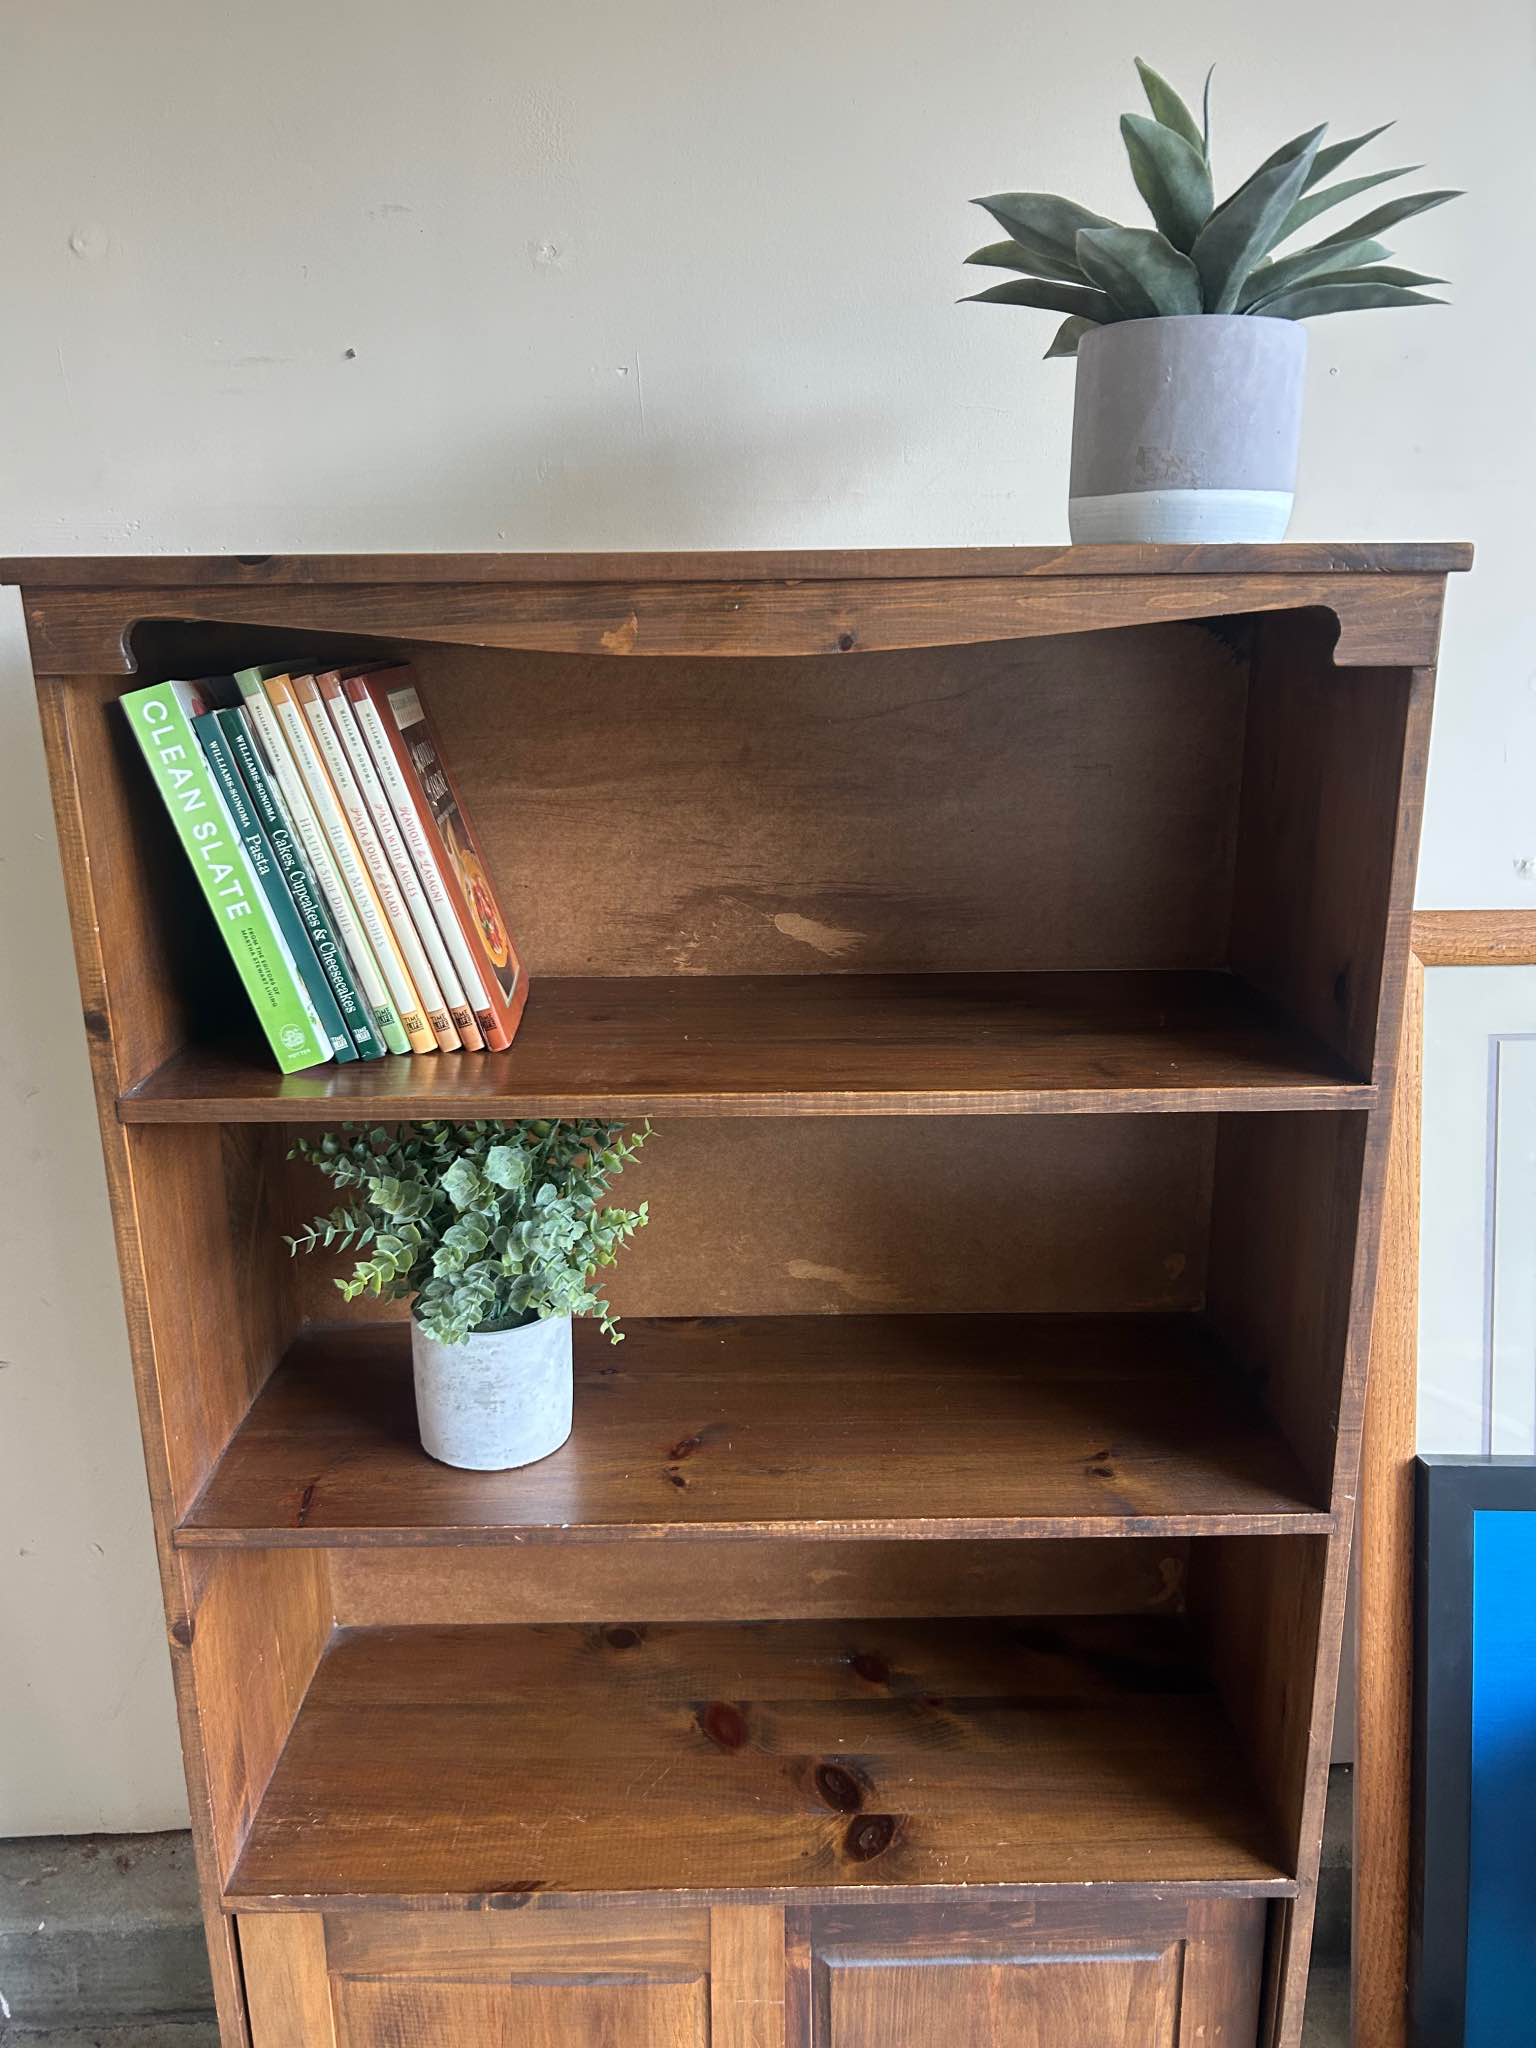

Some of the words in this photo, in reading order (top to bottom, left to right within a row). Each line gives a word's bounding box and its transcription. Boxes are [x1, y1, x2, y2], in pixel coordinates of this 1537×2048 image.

[143, 700, 207, 812] CLEAN
[192, 821, 252, 920] SLATE
[245, 833, 271, 876] Pasta
[272, 829, 295, 871] Cakes,
[299, 817, 326, 868] HEALTHY
[320, 868, 337, 894] SIDE
[331, 895, 352, 934] DISHES
[329, 824, 357, 876] HEALTHY
[350, 875, 370, 908] MAIN
[364, 908, 385, 947] DISHES
[350, 806, 367, 837] PASTA
[361, 837, 381, 870] SOUPS
[379, 880, 401, 918] SALADS
[374, 802, 391, 833] PASTA
[387, 834, 402, 860] WITH
[397, 860, 417, 897] SAUCES
[399, 804, 422, 847] RAVIOLI
[419, 858, 444, 903] LASAGNE
[289, 870, 321, 928] Cupcakes
[312, 928, 328, 941] &
[241, 929, 256, 956] MARTHA
[252, 957, 269, 985] STEWART
[264, 986, 278, 1008] LIVING
[247, 927, 259, 945] FROM
[255, 946, 265, 959] THE
[319, 941, 357, 1014] Cheesecakes
[403, 1014, 419, 1025] TIME
[430, 1013, 446, 1023] TIME
